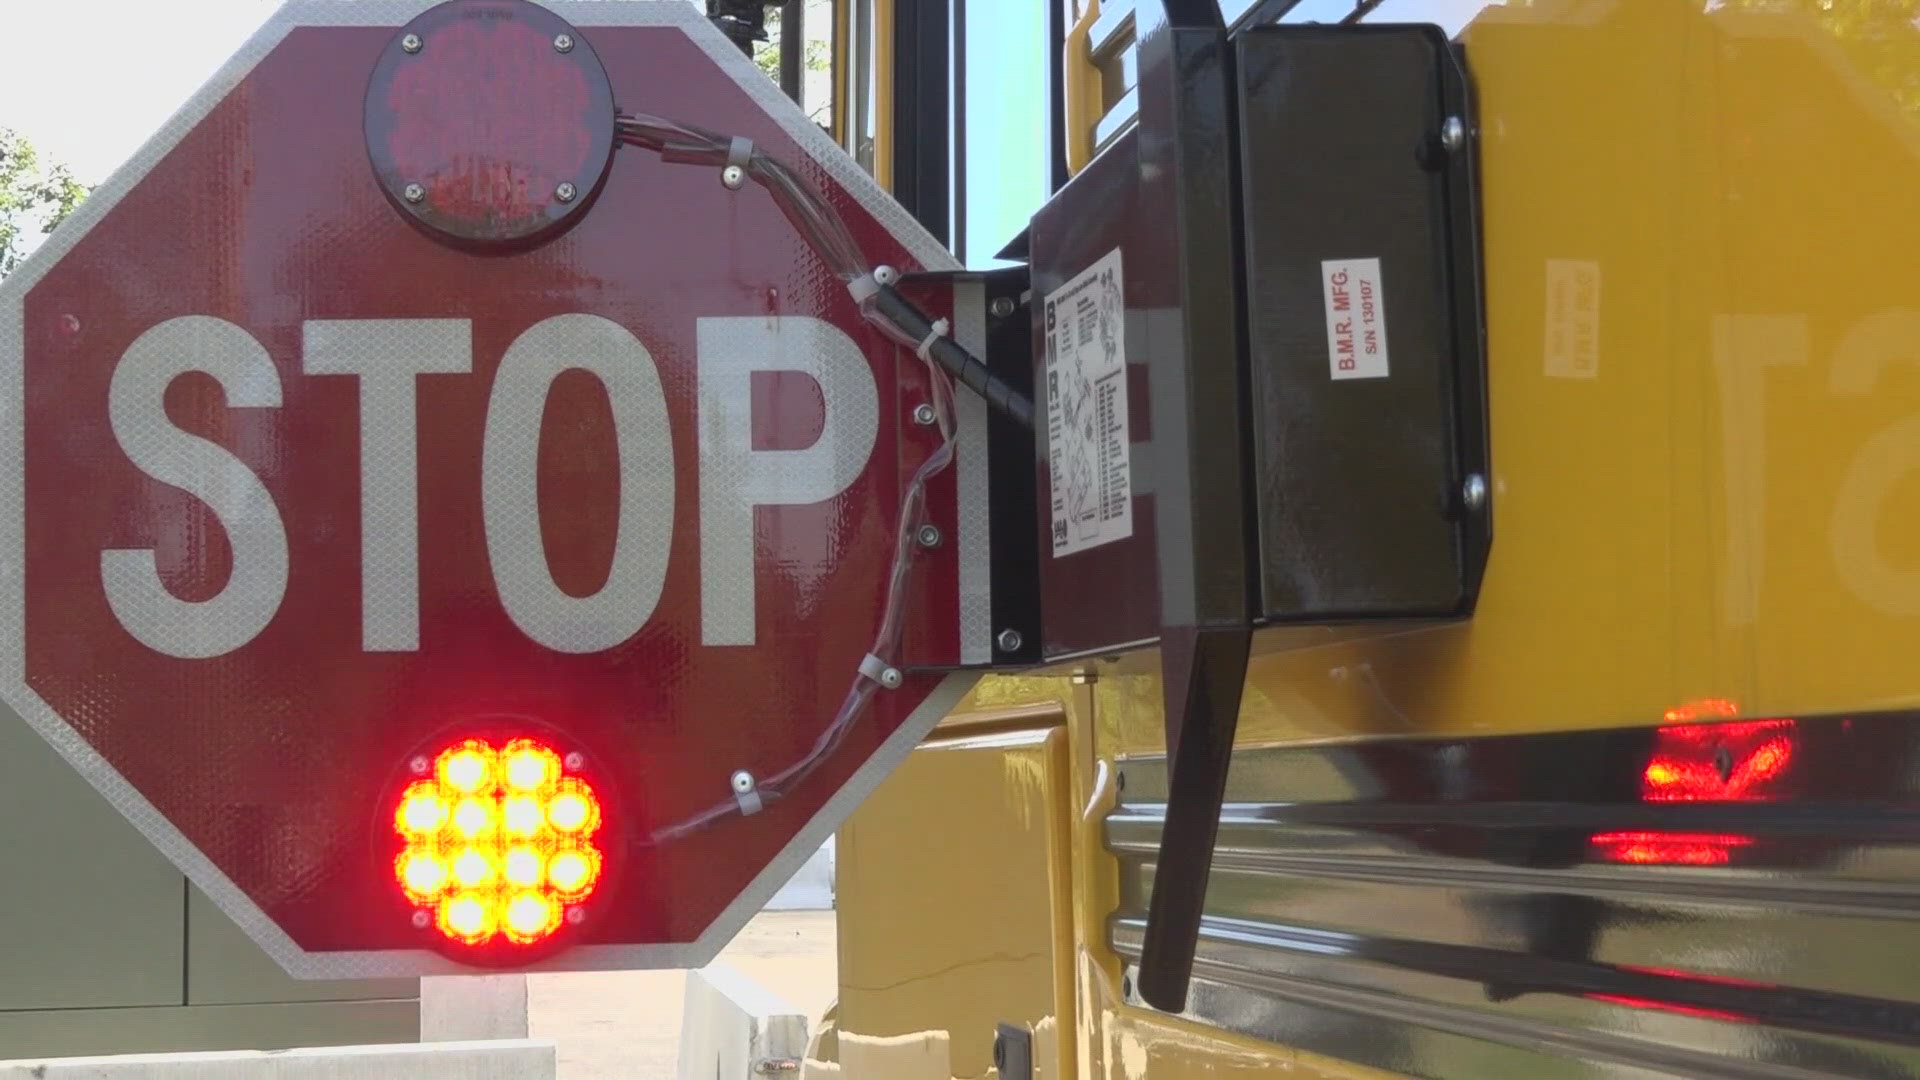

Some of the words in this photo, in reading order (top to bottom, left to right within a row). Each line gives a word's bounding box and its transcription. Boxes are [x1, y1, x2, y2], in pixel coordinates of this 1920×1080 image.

[1331, 268, 1350, 311] MFG.
[1360, 279, 1375, 325] 130107
[1335, 317, 1355, 371] B.M.R.
[1364, 330, 1377, 355] S/N
[101, 313, 879, 658] STOP
